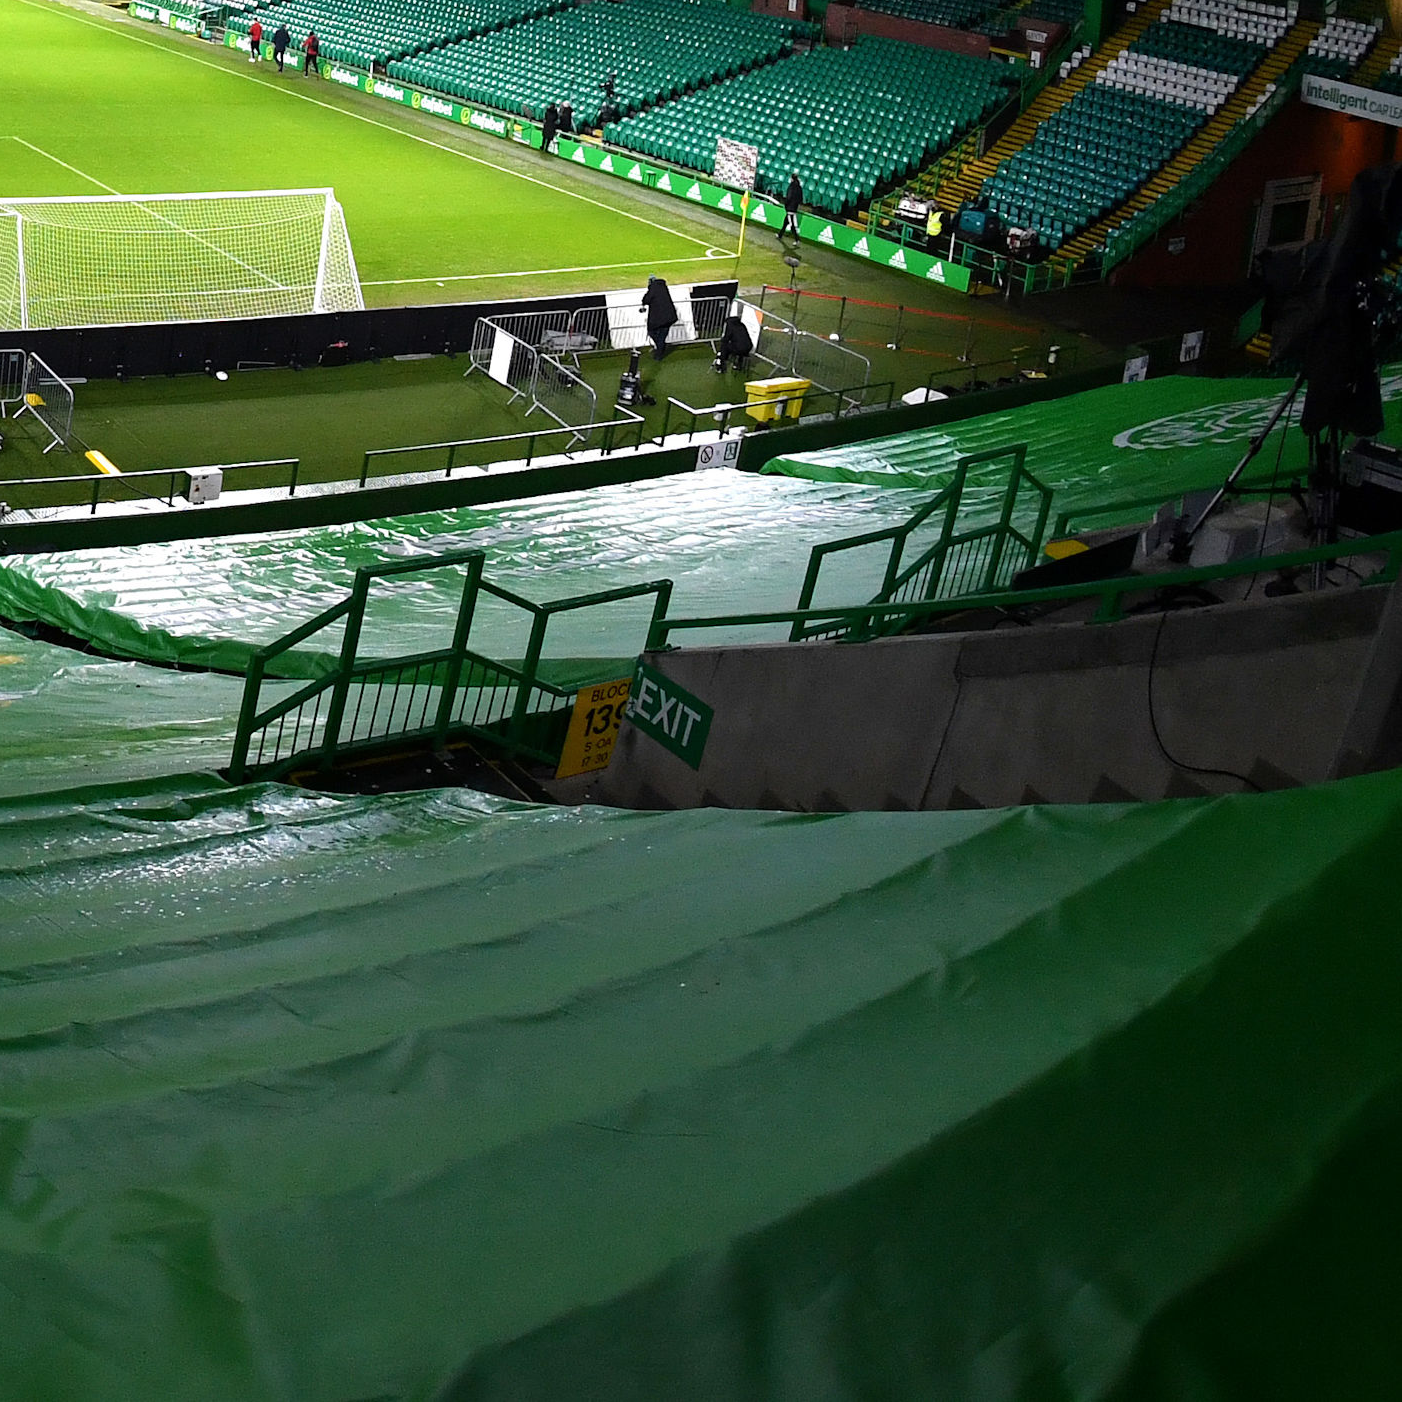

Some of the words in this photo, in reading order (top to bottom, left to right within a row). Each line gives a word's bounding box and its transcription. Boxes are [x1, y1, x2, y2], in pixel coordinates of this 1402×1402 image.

[330, 67, 359, 87] dafabet
[373, 80, 404, 102] dafabet
[1307, 82, 1368, 111] intelligent
[420, 94, 453, 117] dafabet
[470, 111, 505, 135] dafabet
[636, 677, 702, 748] EXIT
